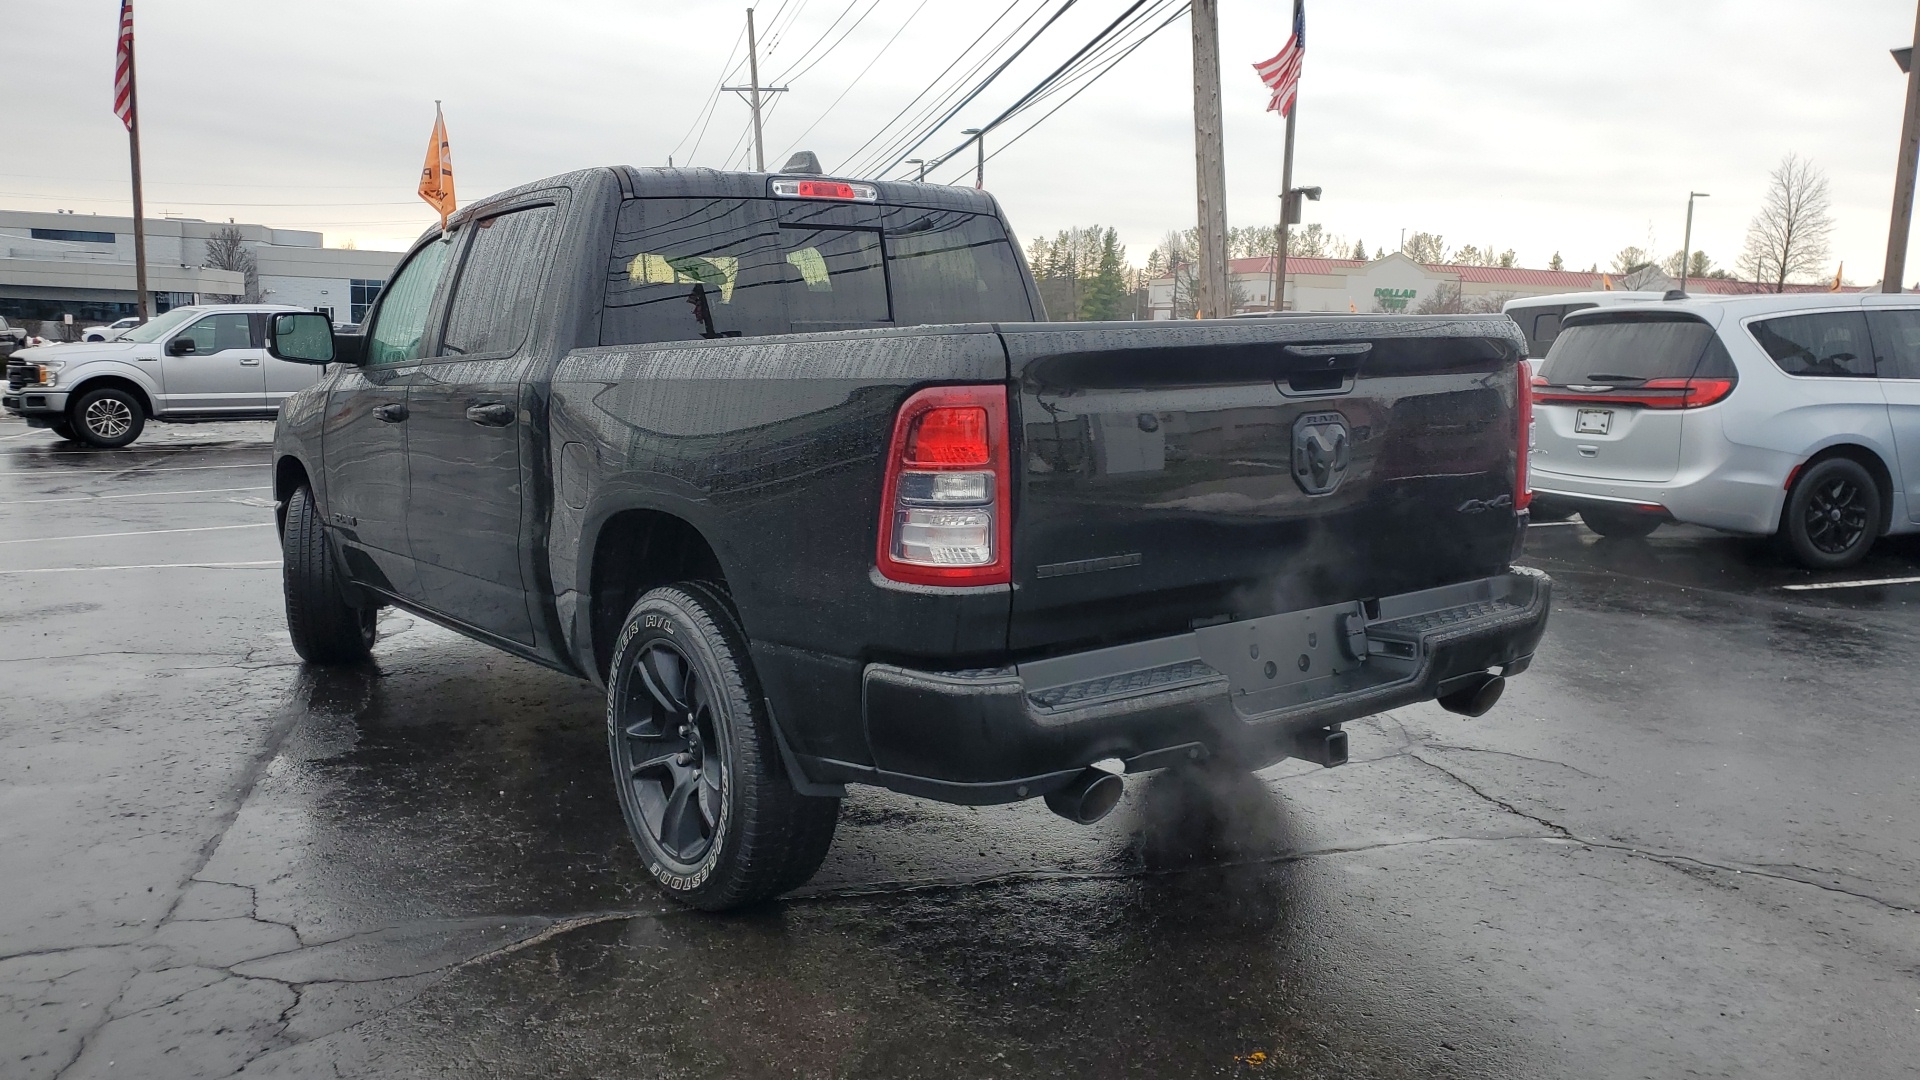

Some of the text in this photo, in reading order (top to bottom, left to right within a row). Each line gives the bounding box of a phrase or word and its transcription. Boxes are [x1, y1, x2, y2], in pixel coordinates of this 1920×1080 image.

[1374, 287, 1417, 299] DOLLAR
[1306, 414, 1339, 423] RAM
[645, 615, 674, 635] H/L
